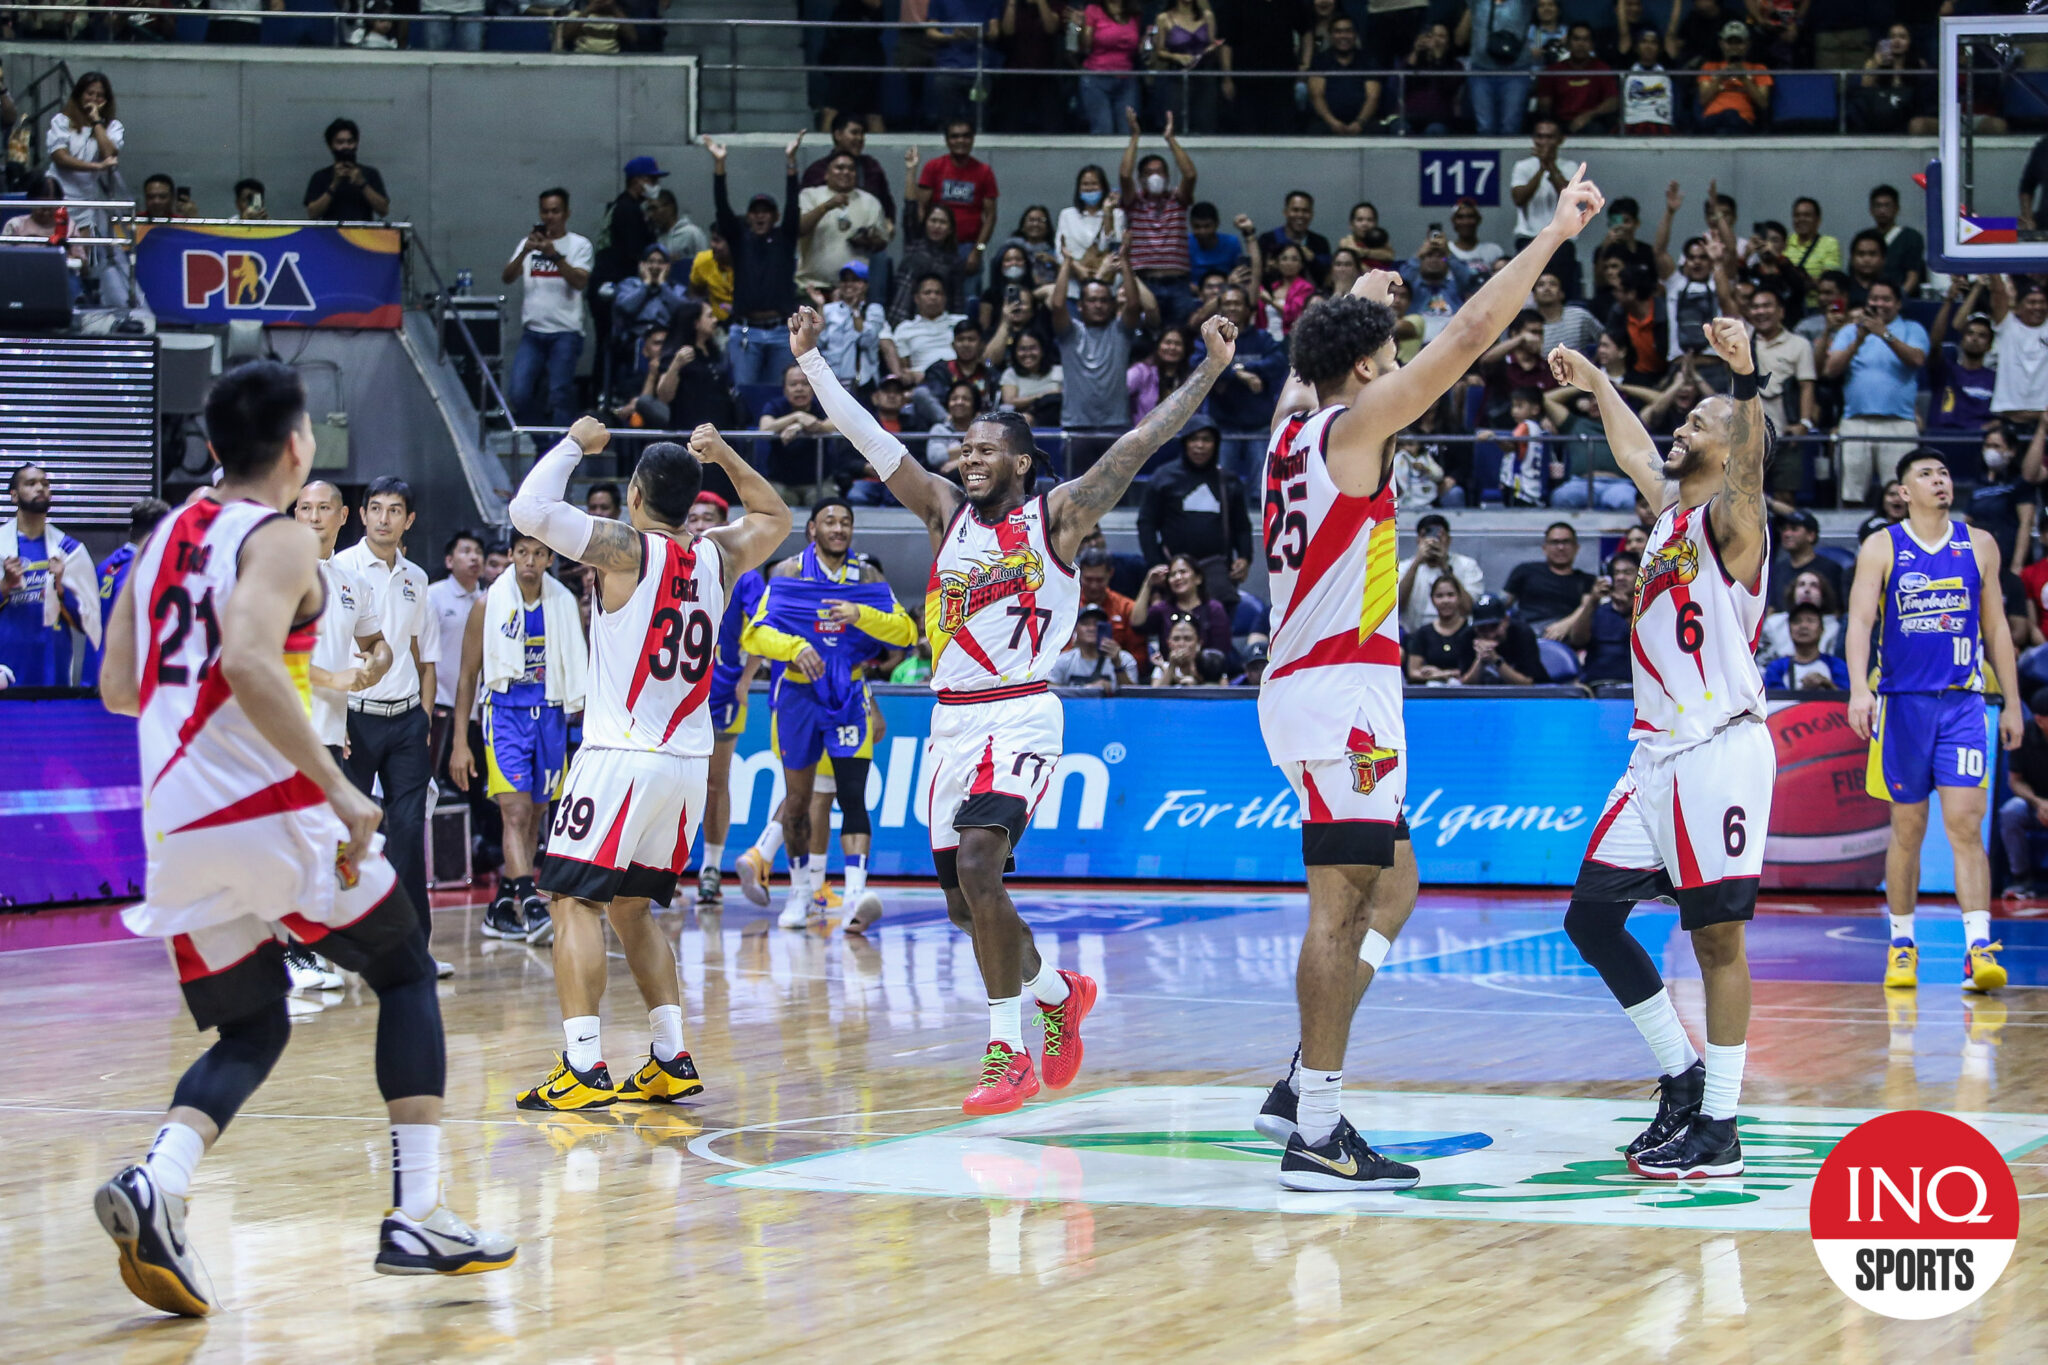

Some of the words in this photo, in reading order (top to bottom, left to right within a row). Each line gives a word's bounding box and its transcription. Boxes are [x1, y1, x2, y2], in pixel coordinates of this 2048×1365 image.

[1424, 160, 1495, 195] 117
[182, 250, 317, 311] PBA
[1265, 482, 1308, 574] 25
[969, 577, 1026, 614] BEERMEN
[155, 585, 222, 687] 21
[649, 607, 713, 684] 39
[1006, 606, 1052, 653] 77
[1676, 601, 1704, 654] 6
[1952, 636, 1972, 666] 10
[836, 725, 860, 747] 13
[1832, 767, 1866, 794] FIB
[1956, 747, 1984, 778] 10
[554, 793, 595, 841] 39
[1144, 789, 1233, 831] For
[1436, 804, 1587, 847] game
[1723, 806, 1746, 857] 6
